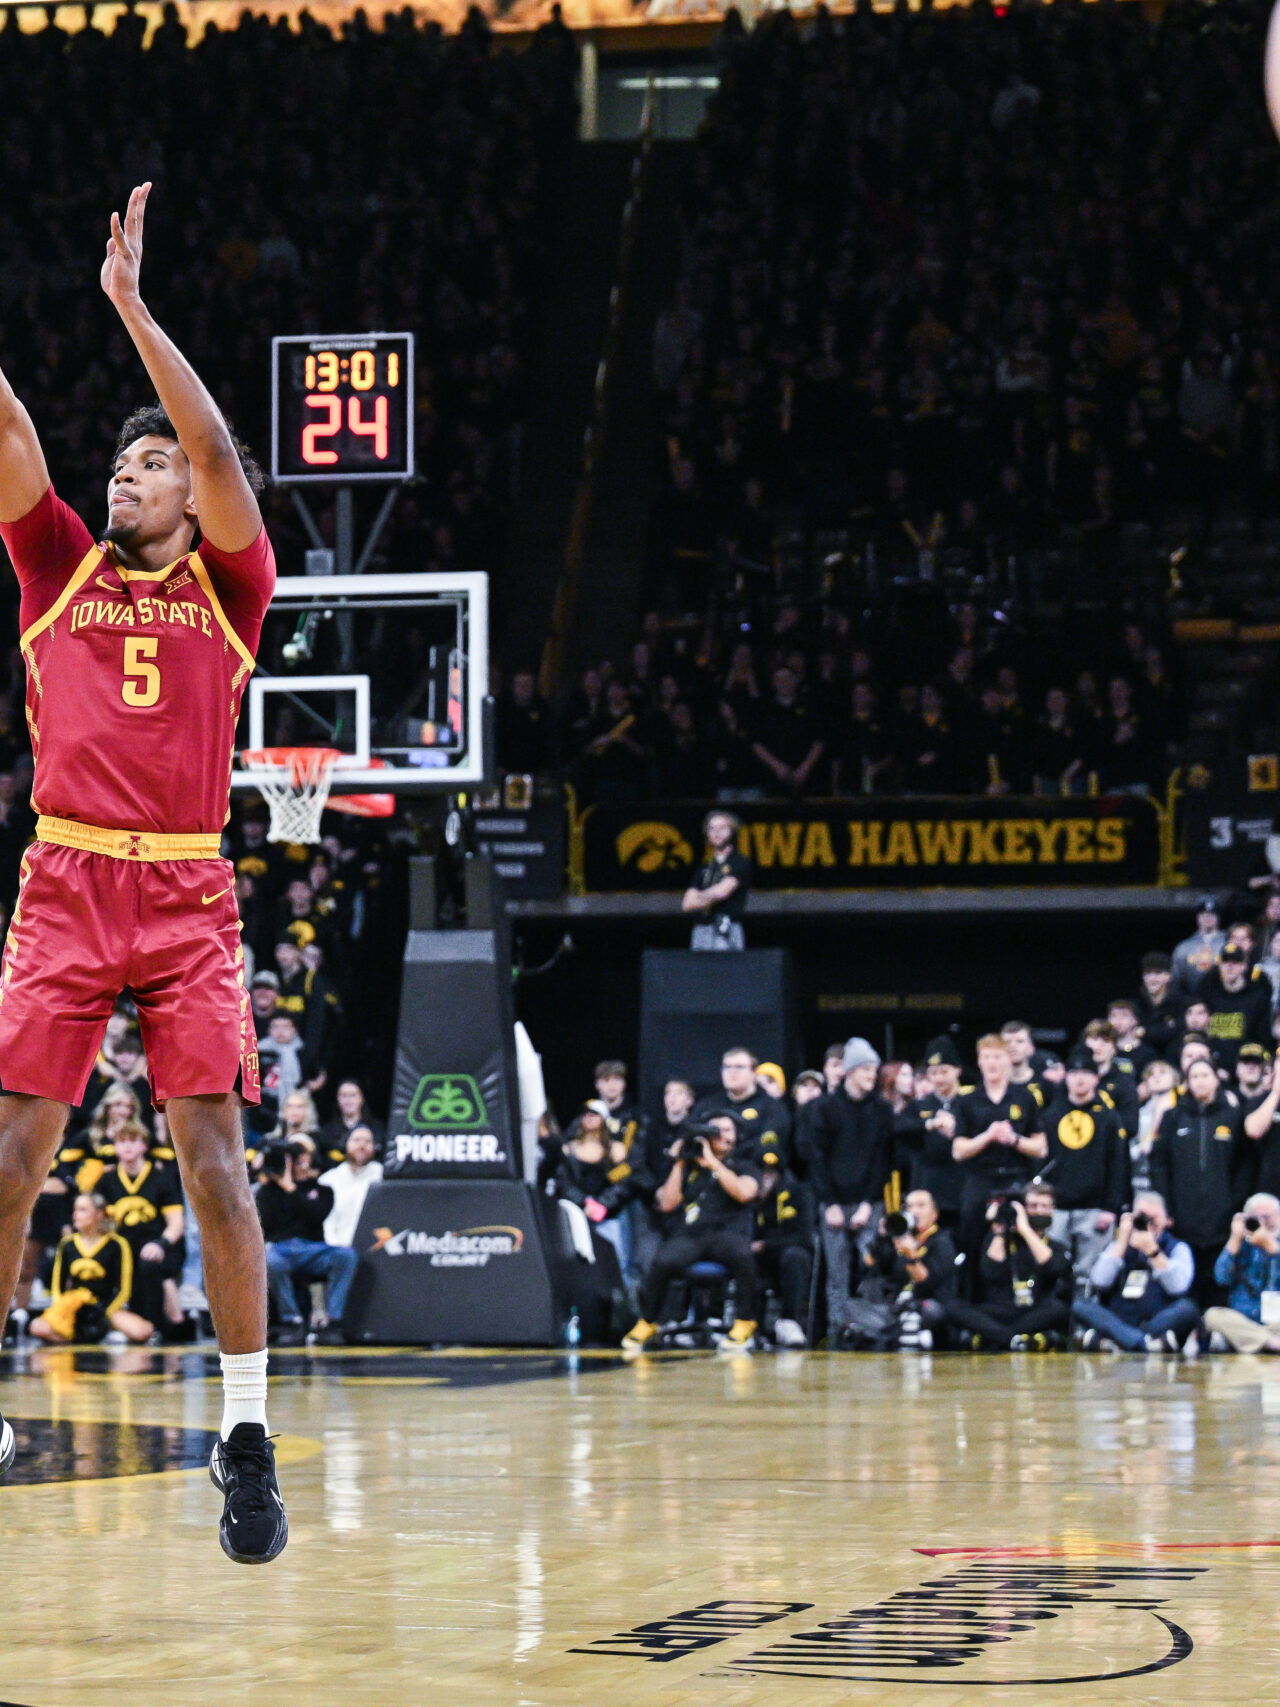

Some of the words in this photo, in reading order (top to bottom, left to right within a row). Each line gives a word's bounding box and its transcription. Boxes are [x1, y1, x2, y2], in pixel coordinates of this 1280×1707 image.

[304, 350, 400, 392] 13:01
[301, 393, 389, 465] 24
[70, 600, 136, 633] IOWA
[136, 597, 214, 640] STATE
[121, 636, 161, 708] 5
[703, 820, 837, 868] WA
[847, 817, 1127, 867] HAWKEYES
[1209, 816, 1233, 848] 3
[406, 1230, 513, 1255] Mediacom
[430, 1253, 491, 1267] COURT
[566, 1600, 815, 1663] COURT
